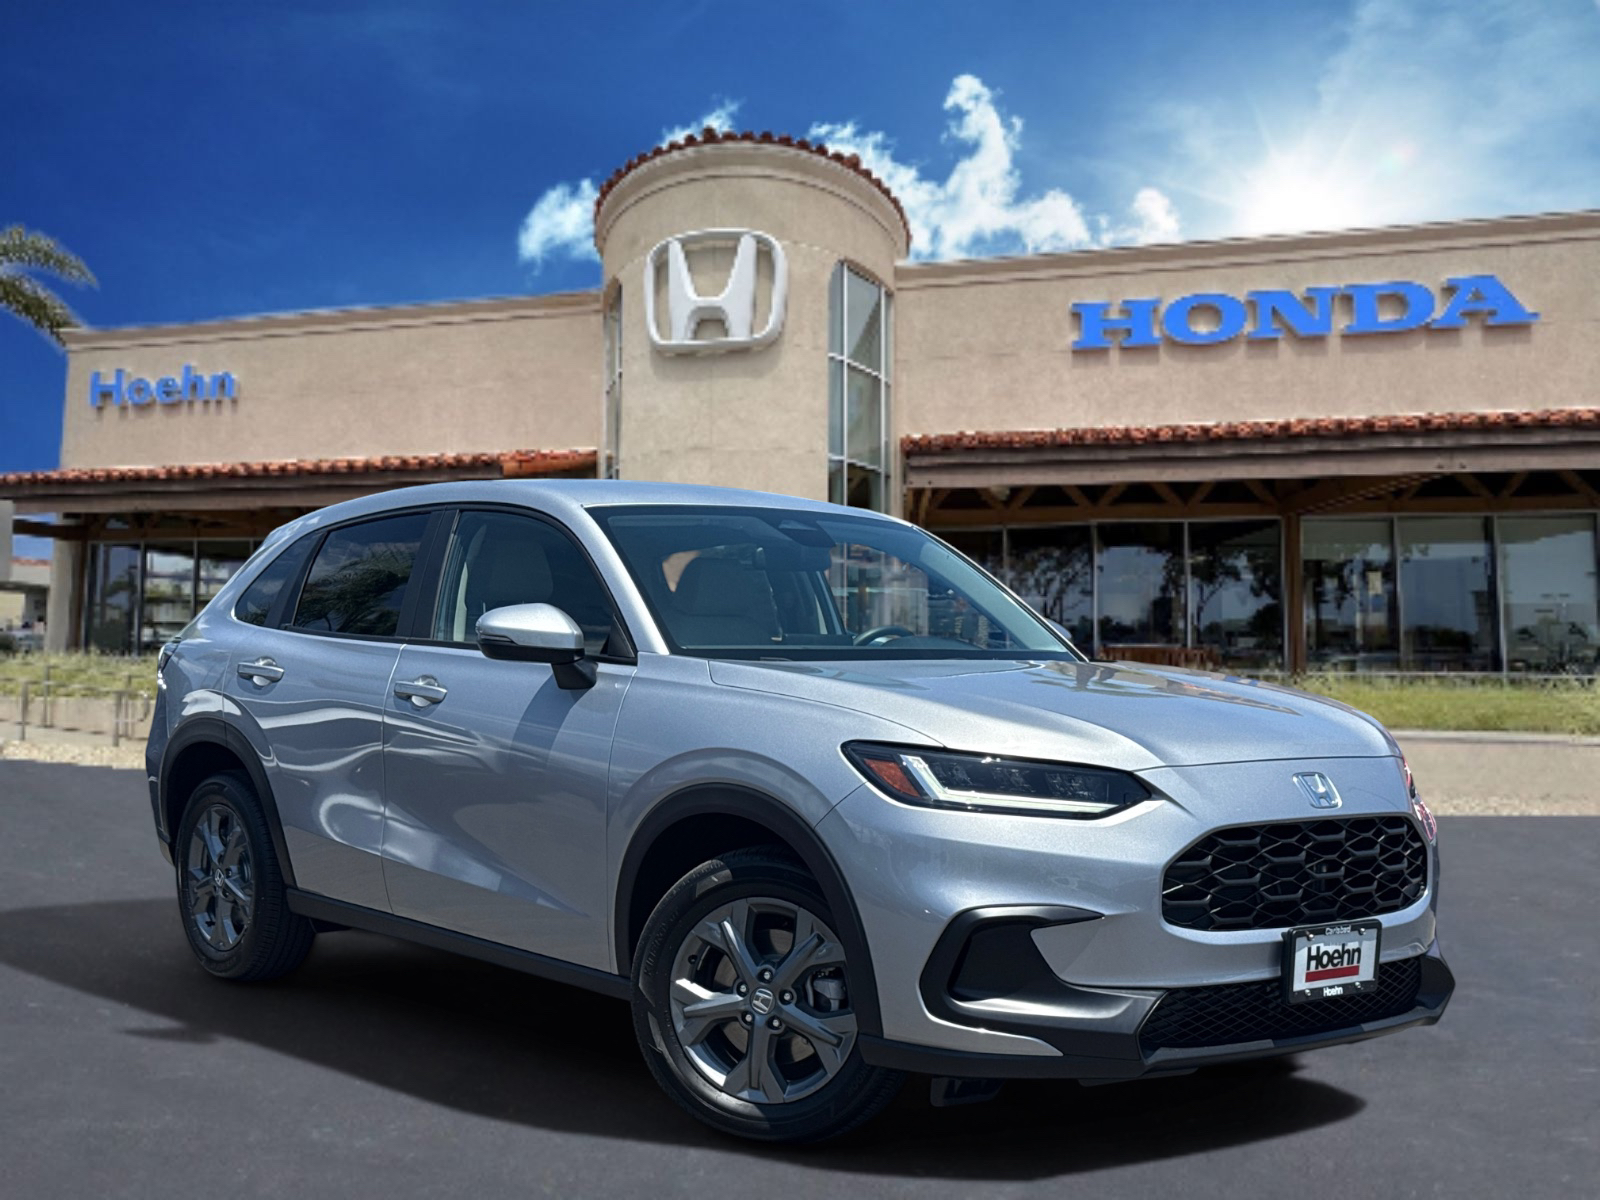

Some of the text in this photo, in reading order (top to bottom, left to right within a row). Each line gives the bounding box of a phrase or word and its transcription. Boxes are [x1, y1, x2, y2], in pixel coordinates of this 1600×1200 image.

[1071, 274, 1540, 350] HONDA
[90, 363, 235, 406] Hoehn
[1306, 943, 1361, 971] Hoehn
[1322, 985, 1344, 997] Hoehn
